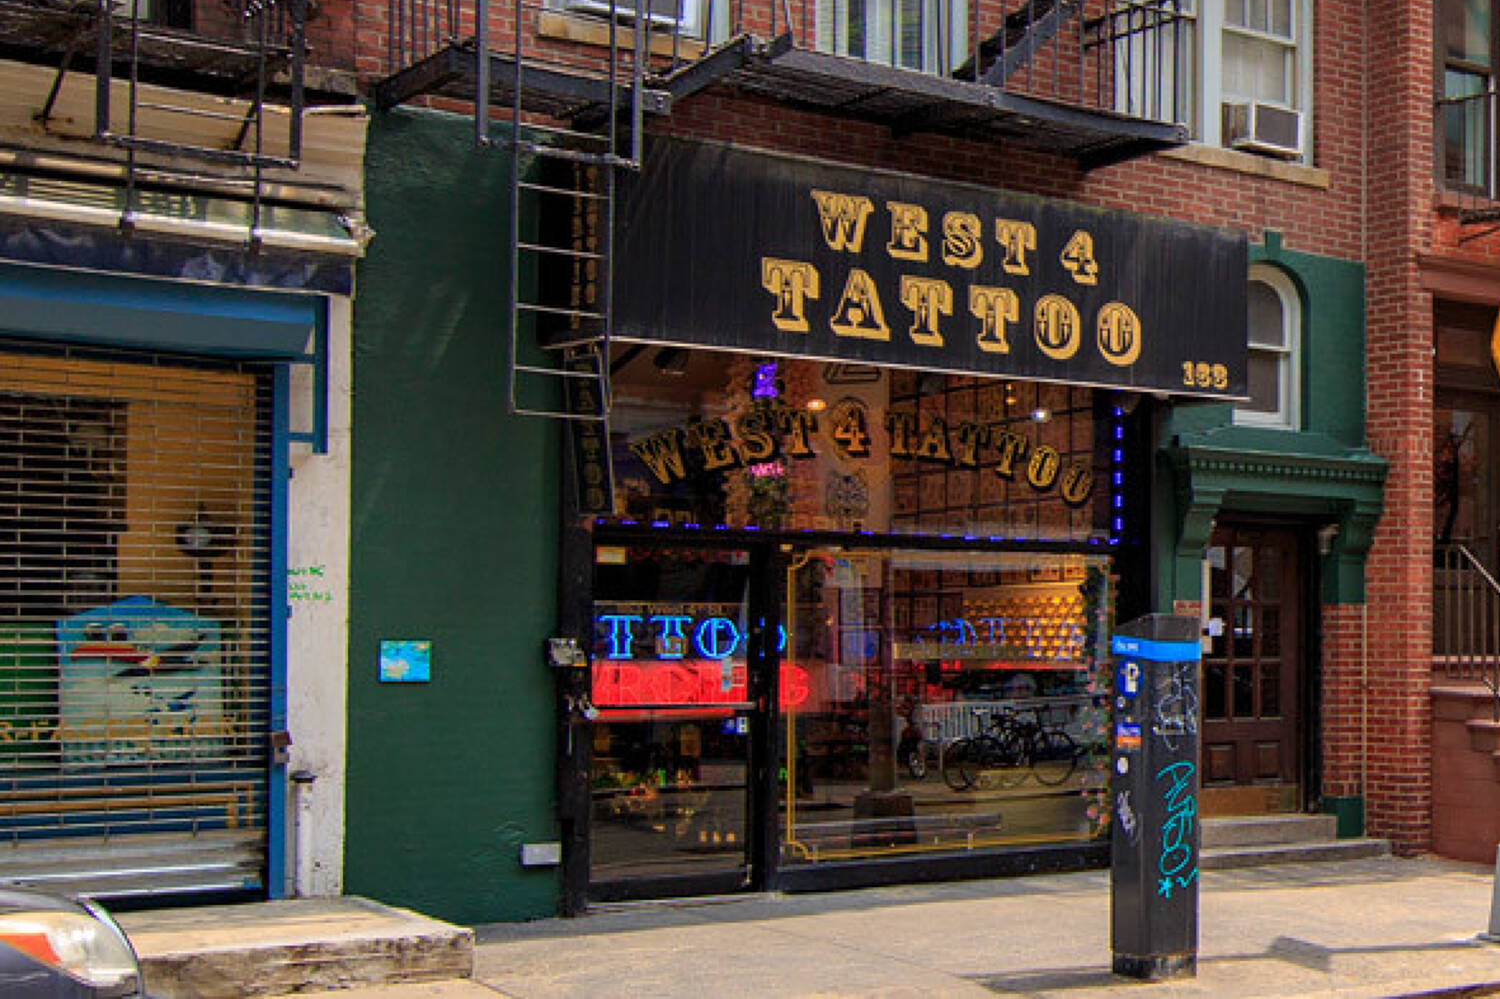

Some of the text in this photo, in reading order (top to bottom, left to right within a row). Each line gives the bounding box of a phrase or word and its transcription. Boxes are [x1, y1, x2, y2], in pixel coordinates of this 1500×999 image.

[811, 190, 1098, 285] WEST 4
[761, 257, 1142, 366] TATTOO
[630, 407, 1094, 506] WEST 4 TATTOO
